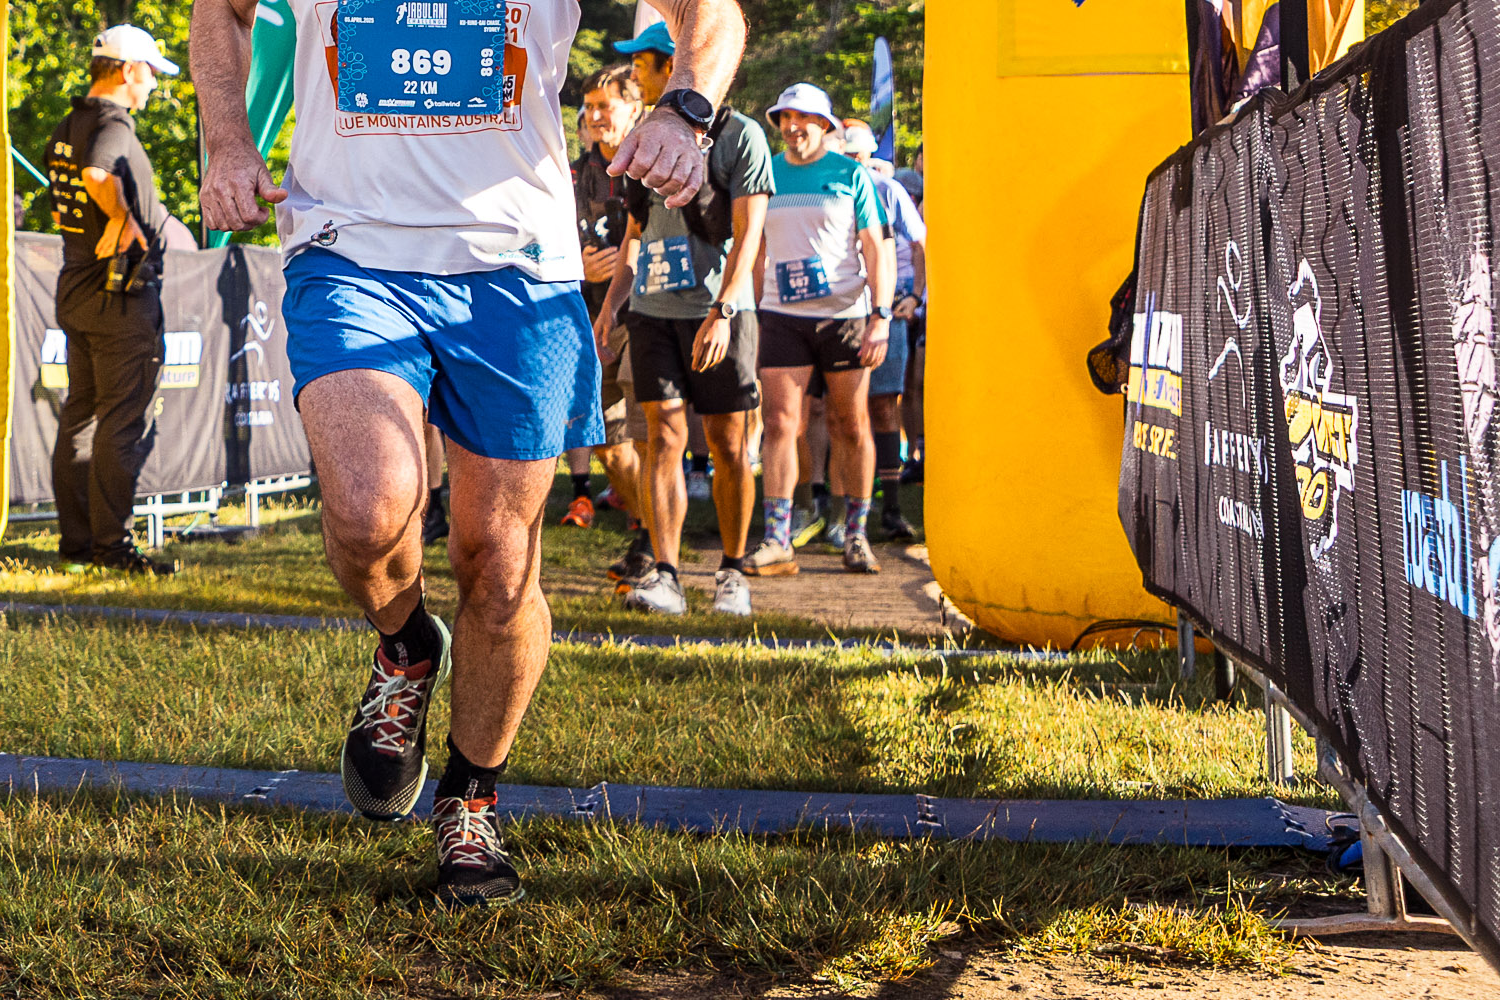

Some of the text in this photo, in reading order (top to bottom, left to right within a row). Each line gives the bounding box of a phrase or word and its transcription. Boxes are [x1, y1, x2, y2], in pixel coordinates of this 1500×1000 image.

[407, 2, 448, 18] JABULANI
[390, 48, 452, 75] 869
[480, 47, 494, 77] 869
[403, 80, 438, 95] 22 KM
[433, 99, 461, 108] tailwind
[339, 115, 365, 130] LUE
[368, 114, 451, 129] MOUNTAINS
